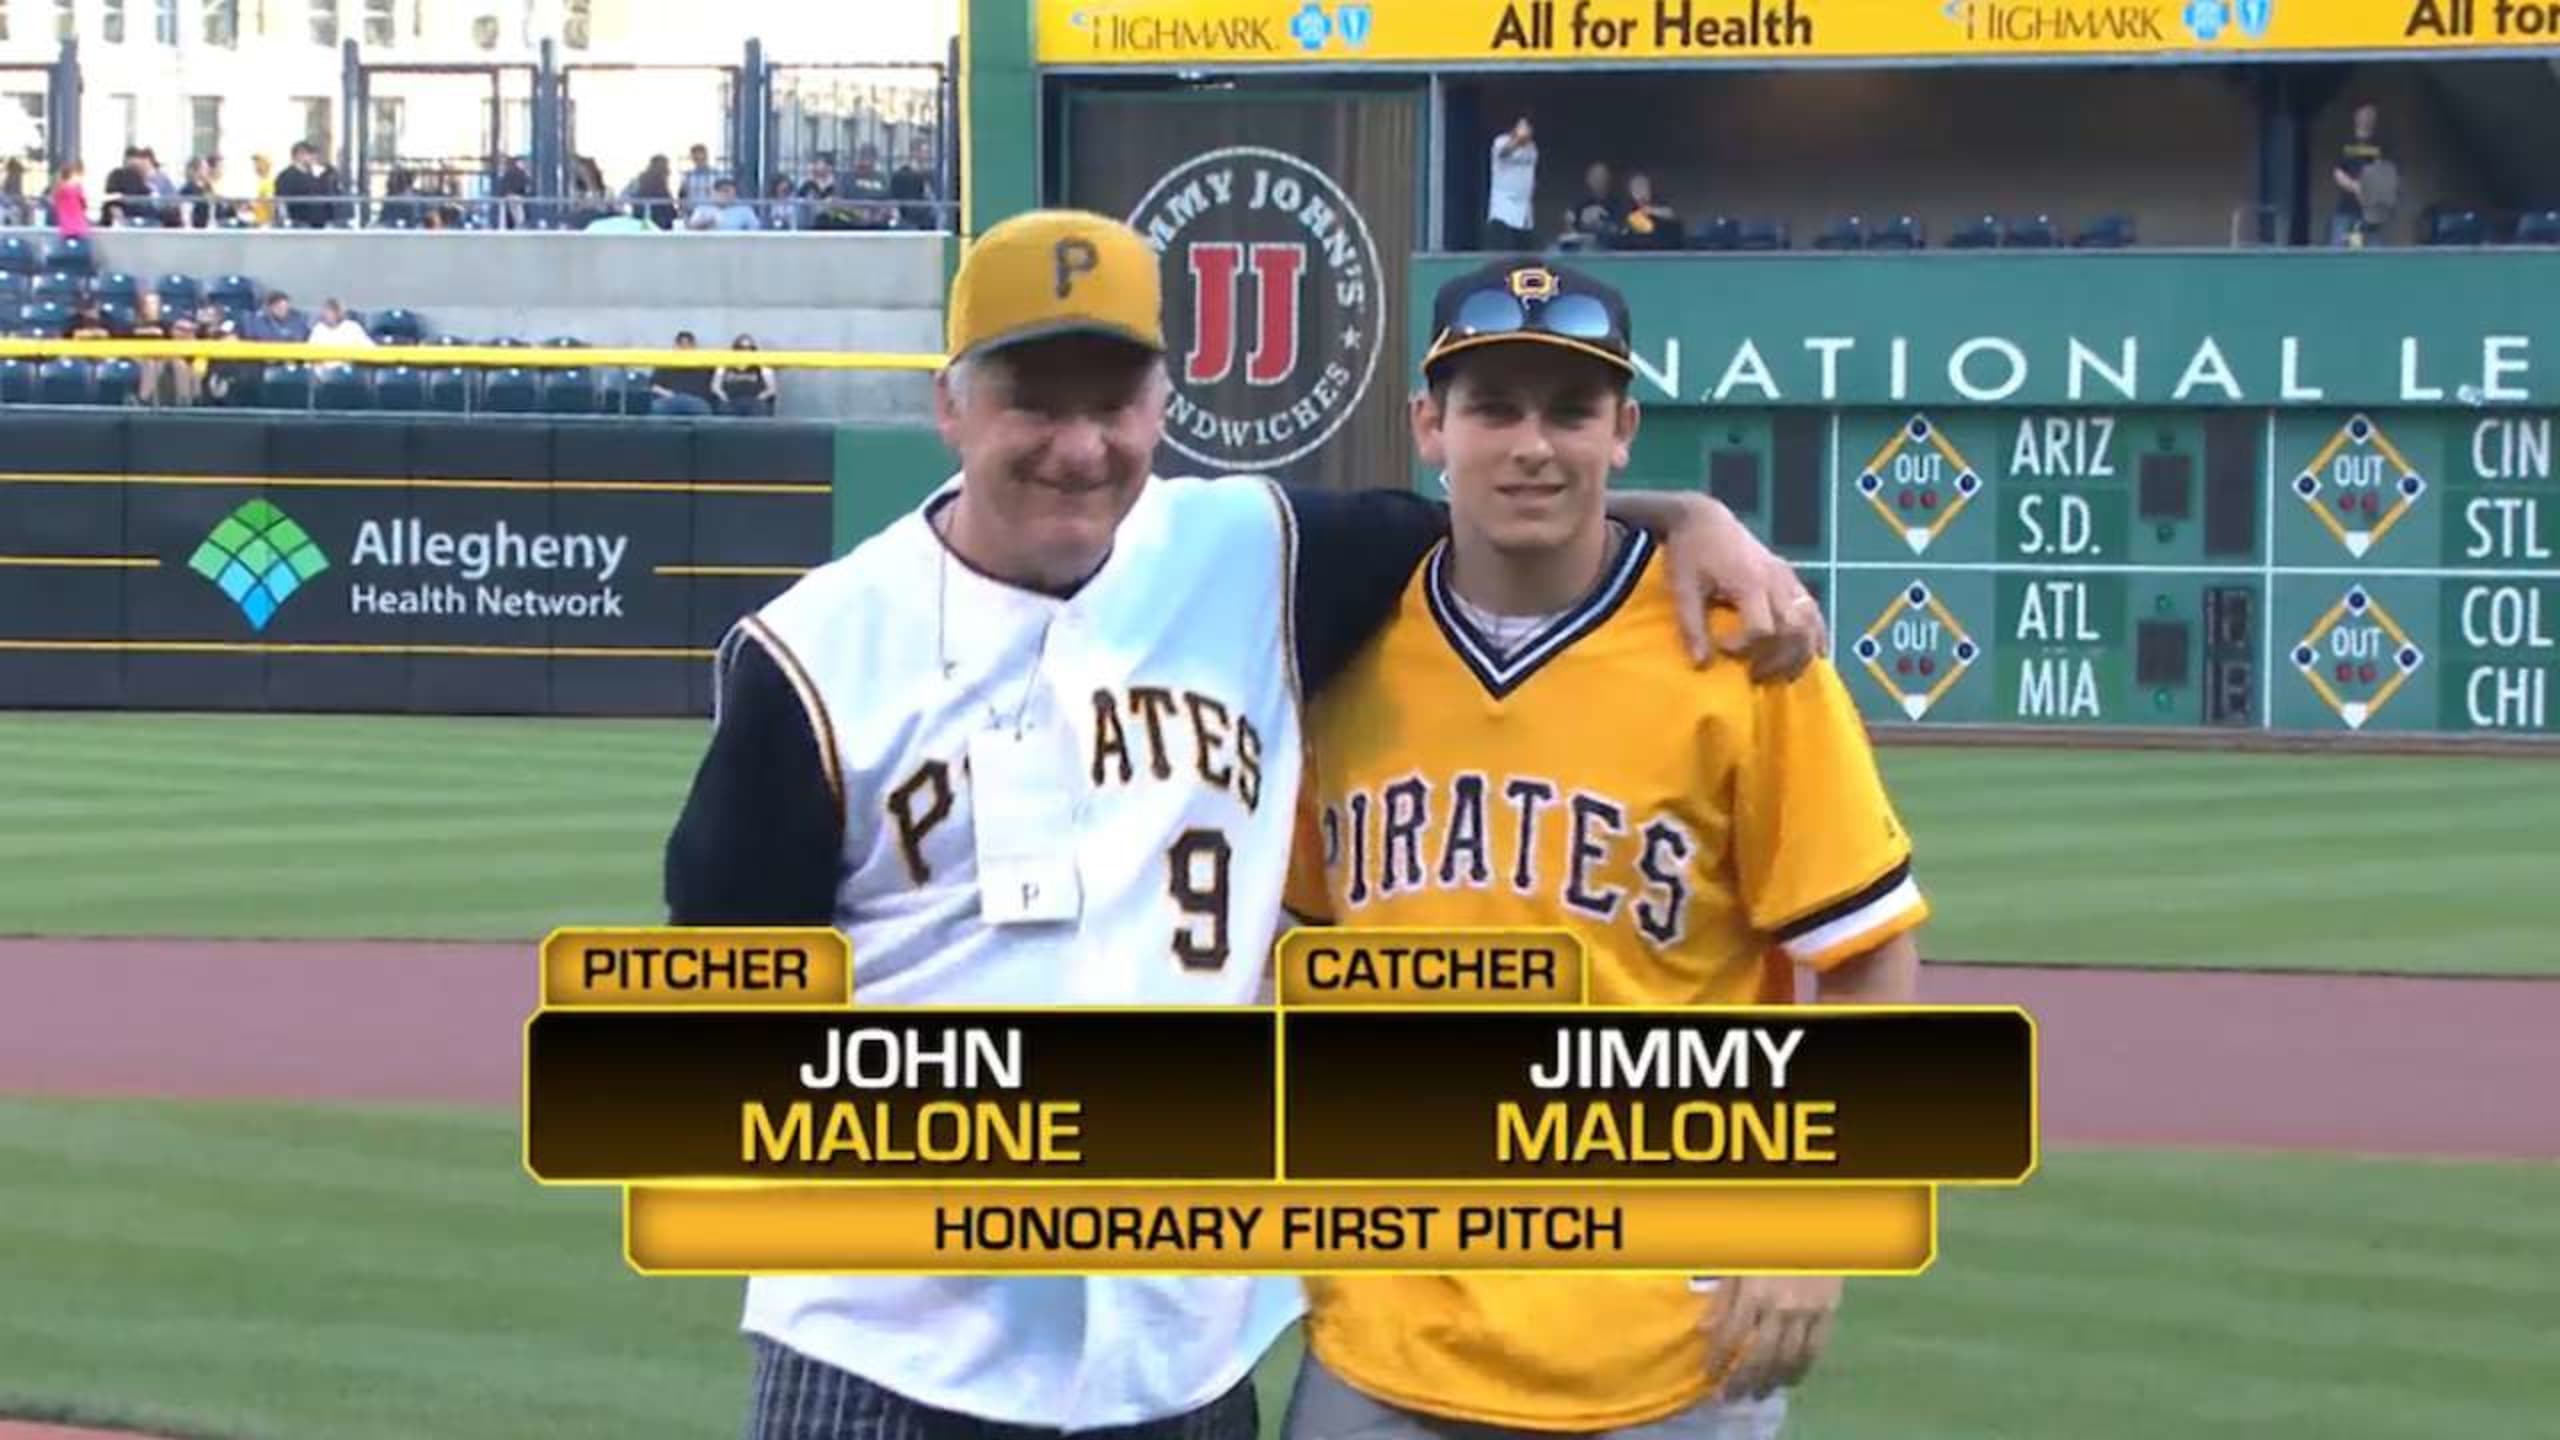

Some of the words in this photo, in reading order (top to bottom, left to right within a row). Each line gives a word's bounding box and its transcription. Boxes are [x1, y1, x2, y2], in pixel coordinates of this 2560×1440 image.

[1491, 2, 1553, 49] All
[1572, 2, 1638, 48] for
[1654, 1, 1813, 47] Health
[2405, 0, 2473, 36] All
[1148, 168, 1233, 251] MMY
[1248, 168, 1365, 308] JOHN'S
[1055, 236, 1100, 300] P
[1185, 242, 1307, 385] JJ
[1630, 335, 2324, 401] NATIONAL
[2400, 336, 2530, 401] LE
[1167, 362, 1350, 447] NDWICHES
[1895, 454, 1942, 485] OUT
[2011, 417, 2115, 476] ARIZ
[2334, 454, 2385, 487] OUT
[2472, 419, 2551, 478] CIN
[351, 519, 628, 580] Allegheny
[2018, 495, 2102, 554] S.D.
[2465, 498, 2551, 558] STL
[351, 584, 464, 614] Health
[476, 588, 624, 618] Network
[2016, 582, 2100, 640] ATL
[2461, 586, 2554, 647] COL
[1892, 620, 1941, 651] OUT
[2331, 626, 2381, 658] OUT
[2017, 660, 2100, 717] MIA
[2467, 667, 2545, 727] CHI
[886, 685, 1263, 889] PATES
[1167, 827, 1233, 972] 9
